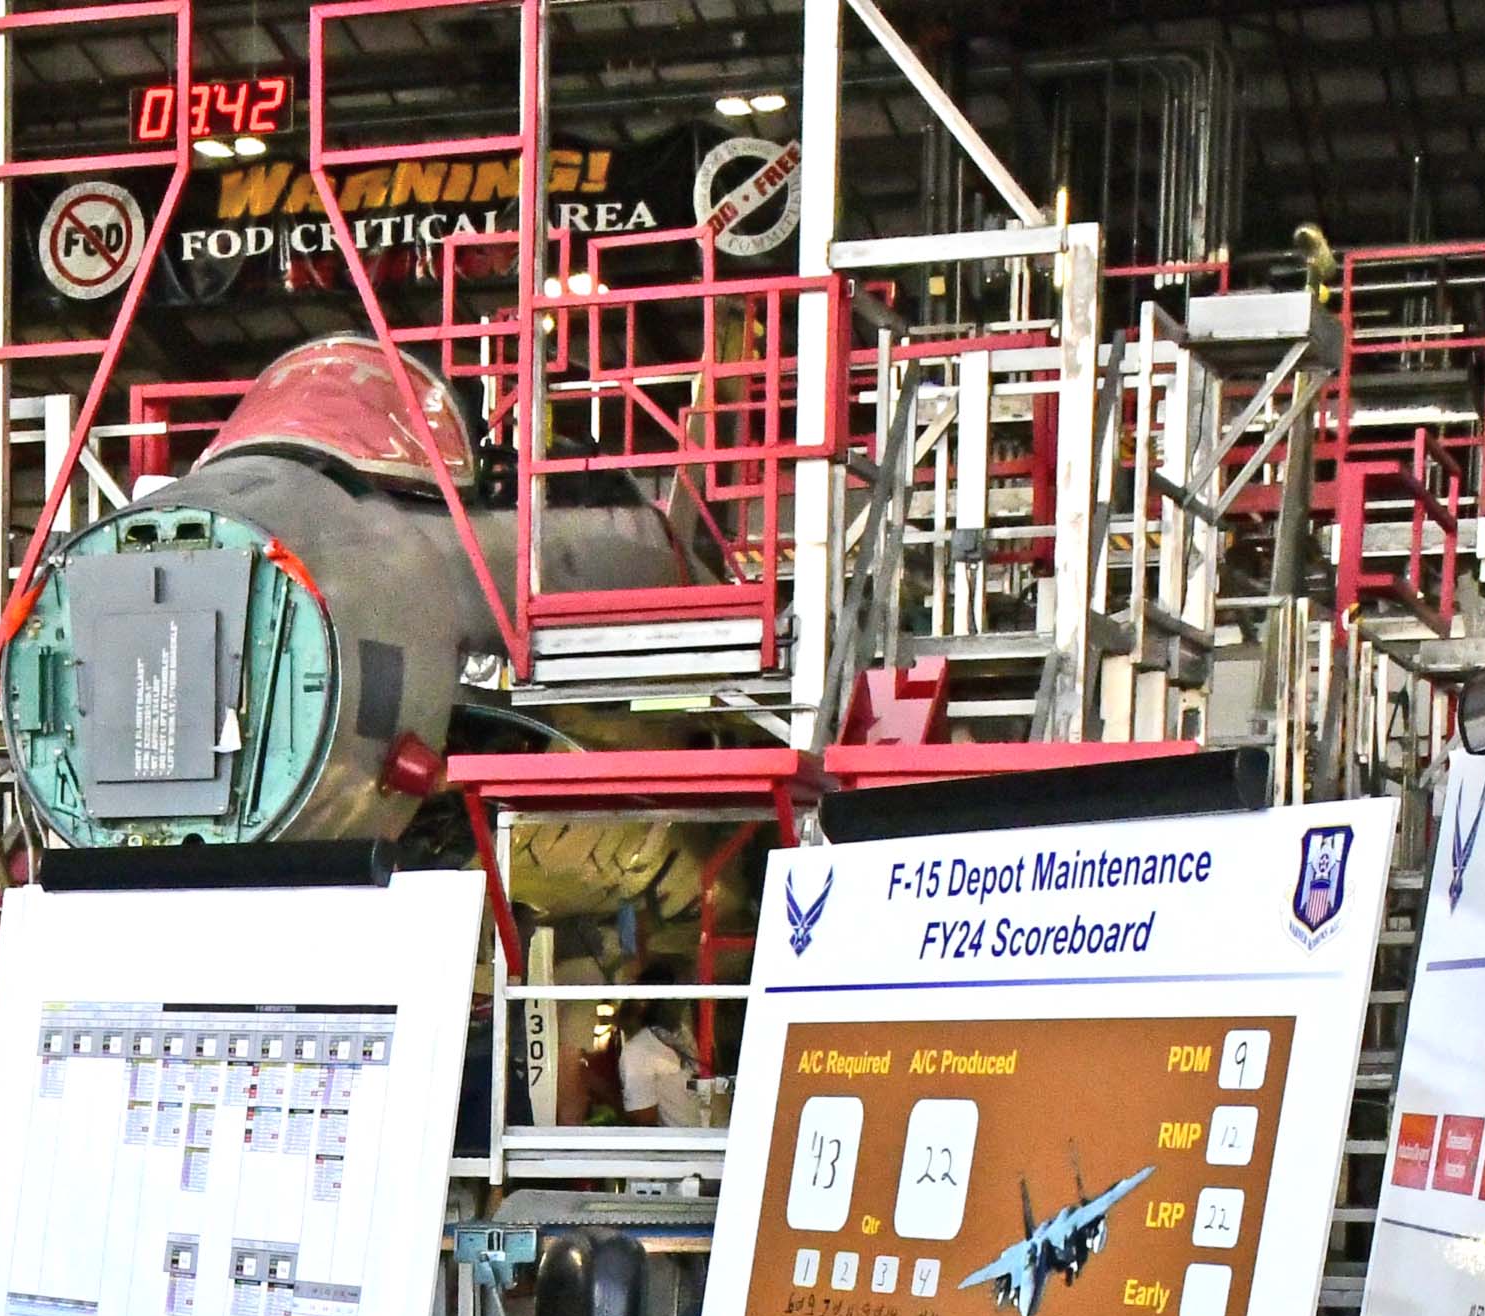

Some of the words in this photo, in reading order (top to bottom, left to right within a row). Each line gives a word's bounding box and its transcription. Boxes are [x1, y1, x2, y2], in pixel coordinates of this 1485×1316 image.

[181, 226, 274, 262] FOD
[546, 199, 658, 233] REA
[888, 860, 942, 900] F-15
[947, 856, 1025, 905] Depot
[1031, 849, 1212, 892] Maintenance
[919, 919, 986, 960] FY24
[991, 910, 1156, 957] Scoreboard
[798, 1050, 824, 1074] A/C
[826, 1050, 891, 1078] Required
[909, 1050, 937, 1074] A/C
[940, 1050, 1018, 1075] Produced
[1167, 1046, 1212, 1072] PDM
[1234, 1041, 1248, 1088] 9
[1158, 1123, 1202, 1149] RMP
[1220, 1126, 1241, 1148] 12
[811, 1131, 842, 1189] 43
[916, 1146, 958, 1186] 22
[862, 1215, 881, 1235] Qtr
[1145, 1201, 1185, 1228] LRP
[1203, 1204, 1230, 1231] 22
[803, 1257, 811, 1282] 1
[839, 1261, 849, 1283] 2
[876, 1262, 888, 1287] 3
[919, 1268, 932, 1296] 4
[1123, 1279, 1170, 1314] Early
